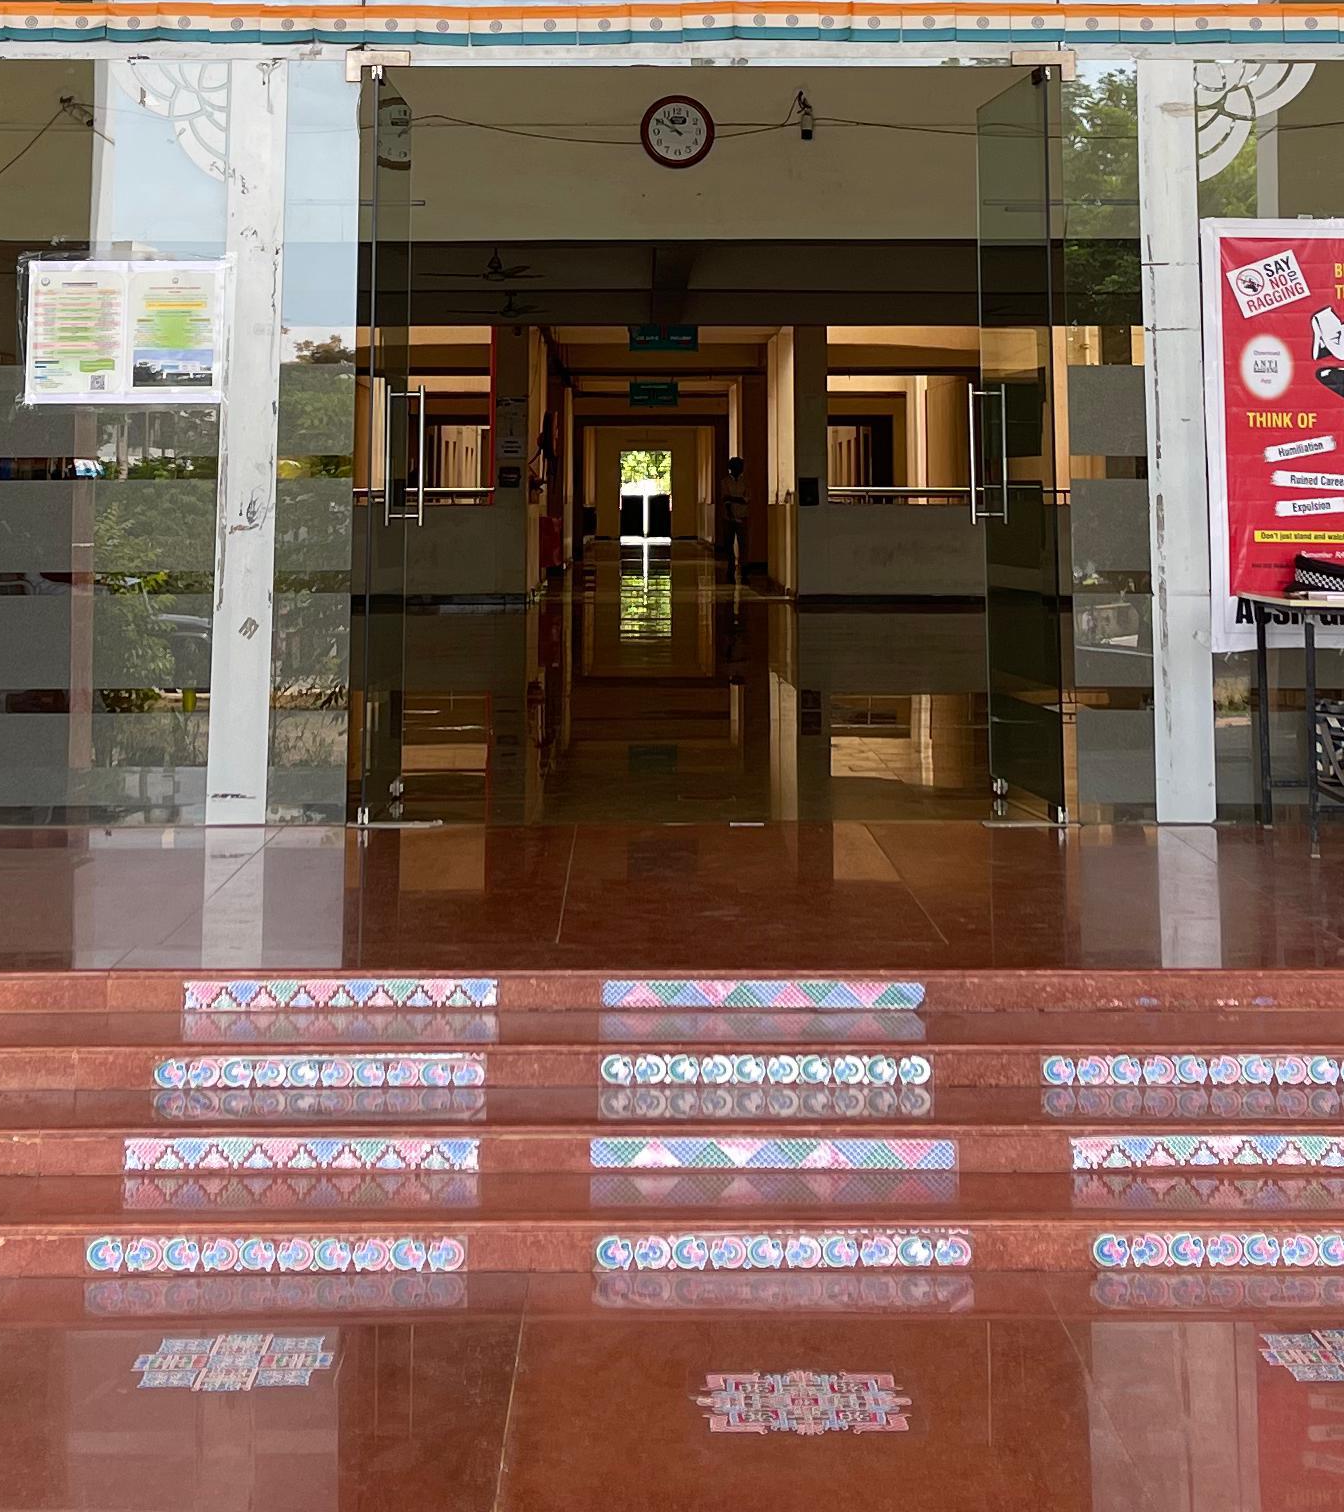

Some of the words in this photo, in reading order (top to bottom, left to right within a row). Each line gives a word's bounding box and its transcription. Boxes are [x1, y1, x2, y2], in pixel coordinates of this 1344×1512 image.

[1263, 256, 1292, 278] SAY
[1269, 273, 1288, 290] NO
[1287, 270, 1299, 284] TO
[1246, 282, 1305, 313] RAGGING
[1247, 412, 1293, 428] THINK
[1297, 413, 1317, 428] OF
[1278, 441, 1324, 457] Humiliation
[1290, 474, 1318, 486] Ruined
[1292, 501, 1331, 514] Expulsion
